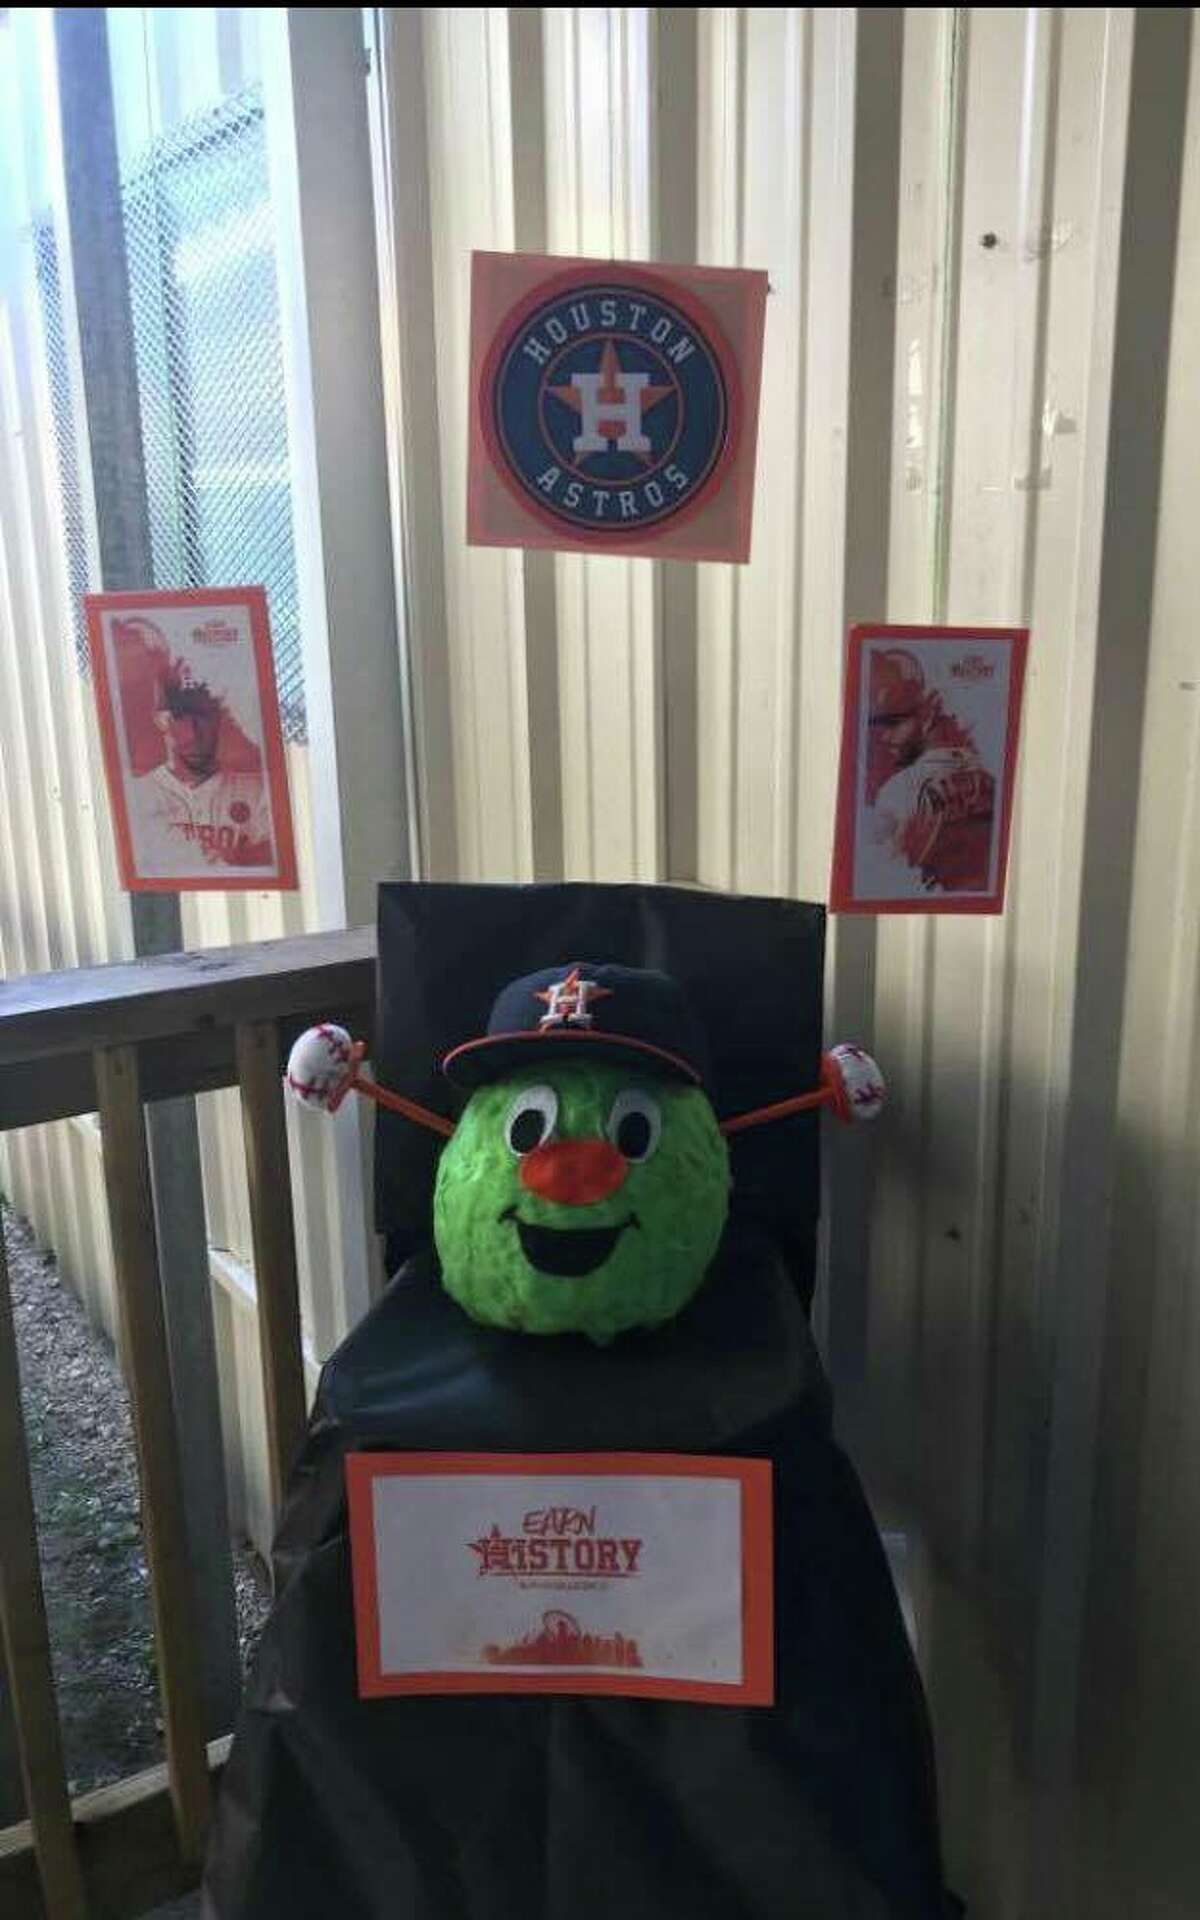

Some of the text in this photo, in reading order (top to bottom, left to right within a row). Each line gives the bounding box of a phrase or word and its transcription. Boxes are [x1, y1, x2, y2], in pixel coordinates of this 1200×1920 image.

[523, 300, 696, 365] HOUSTON
[571, 372, 651, 451] H
[537, 465, 690, 517] ASTROS
[539, 980, 599, 1025] H
[474, 1537, 642, 1573] HISTORY
